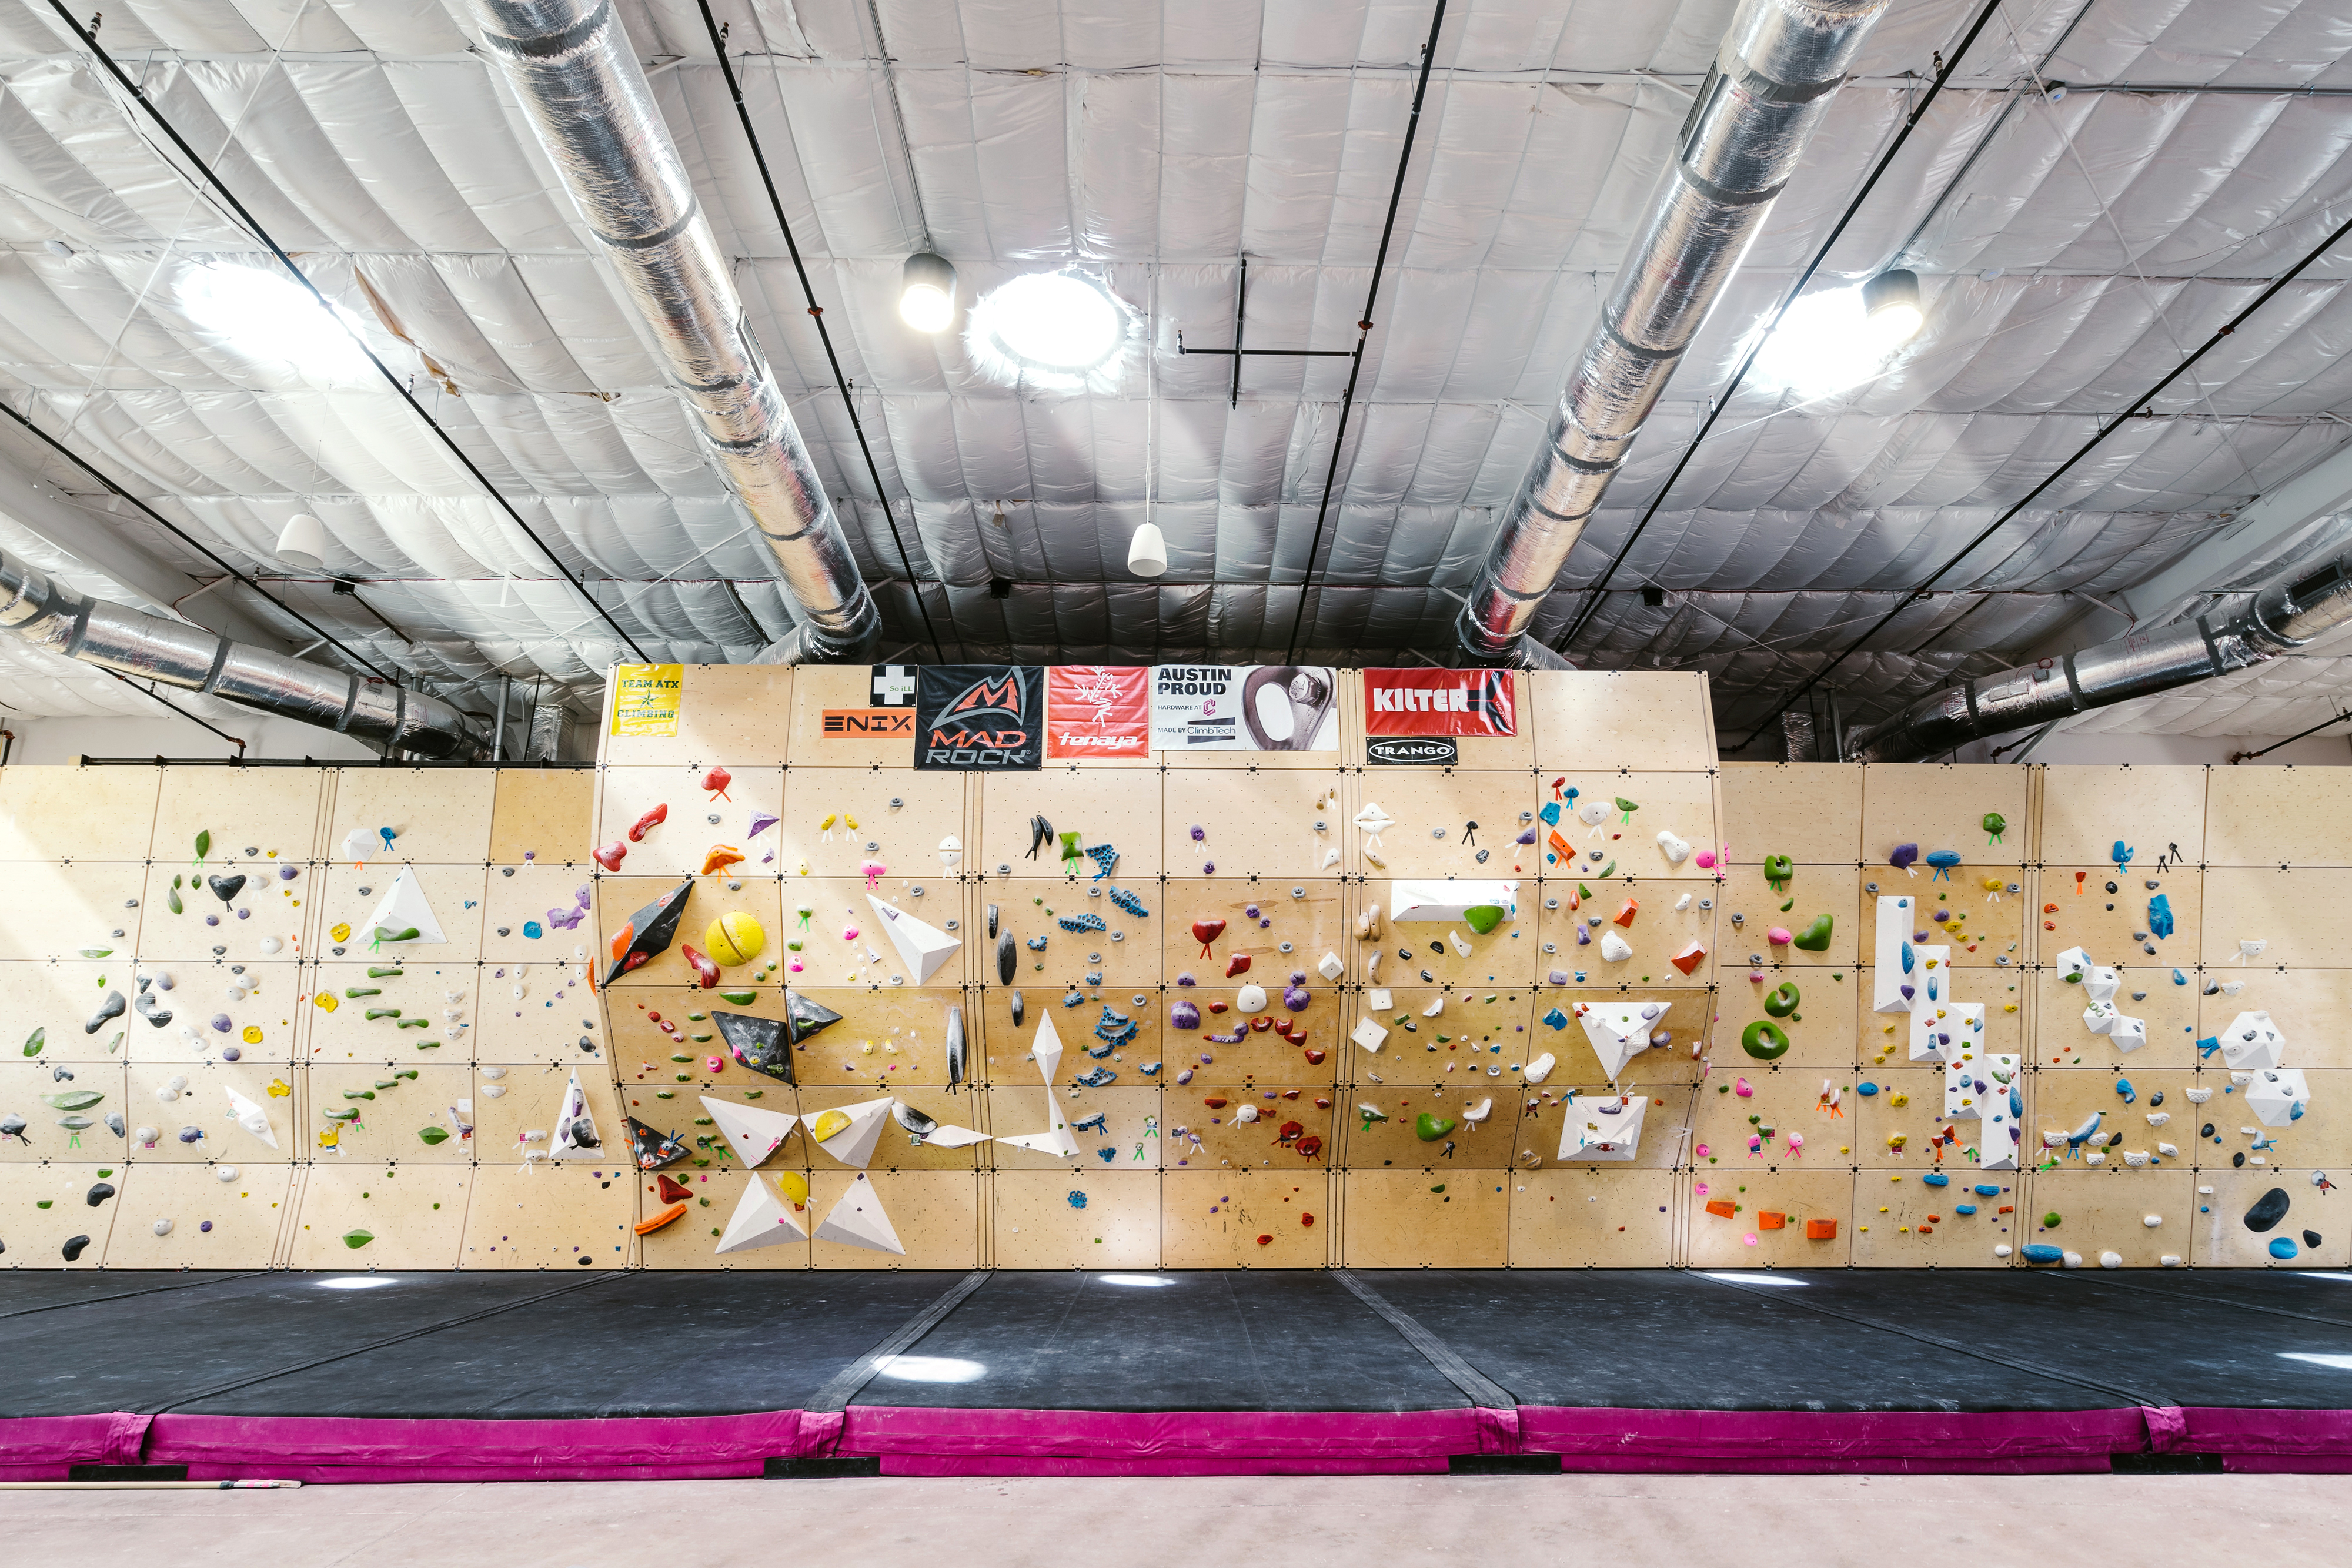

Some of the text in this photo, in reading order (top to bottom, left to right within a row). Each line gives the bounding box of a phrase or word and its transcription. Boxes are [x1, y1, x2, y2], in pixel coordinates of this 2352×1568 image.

[1157, 668, 1232, 681] AUSTIN
[656, 680, 679, 688] ATX
[1157, 682, 1227, 696] PROUD
[1373, 688, 1469, 713] KILTER
[617, 710, 674, 718] CLIMBING
[824, 715, 913, 732] ENIX
[1187, 726, 1236, 734] ClimbTech
[930, 730, 1027, 748] MAD
[1058, 731, 1138, 750] tenaya
[925, 749, 1027, 764] ROCK
[1374, 746, 1450, 755] TRANGO
